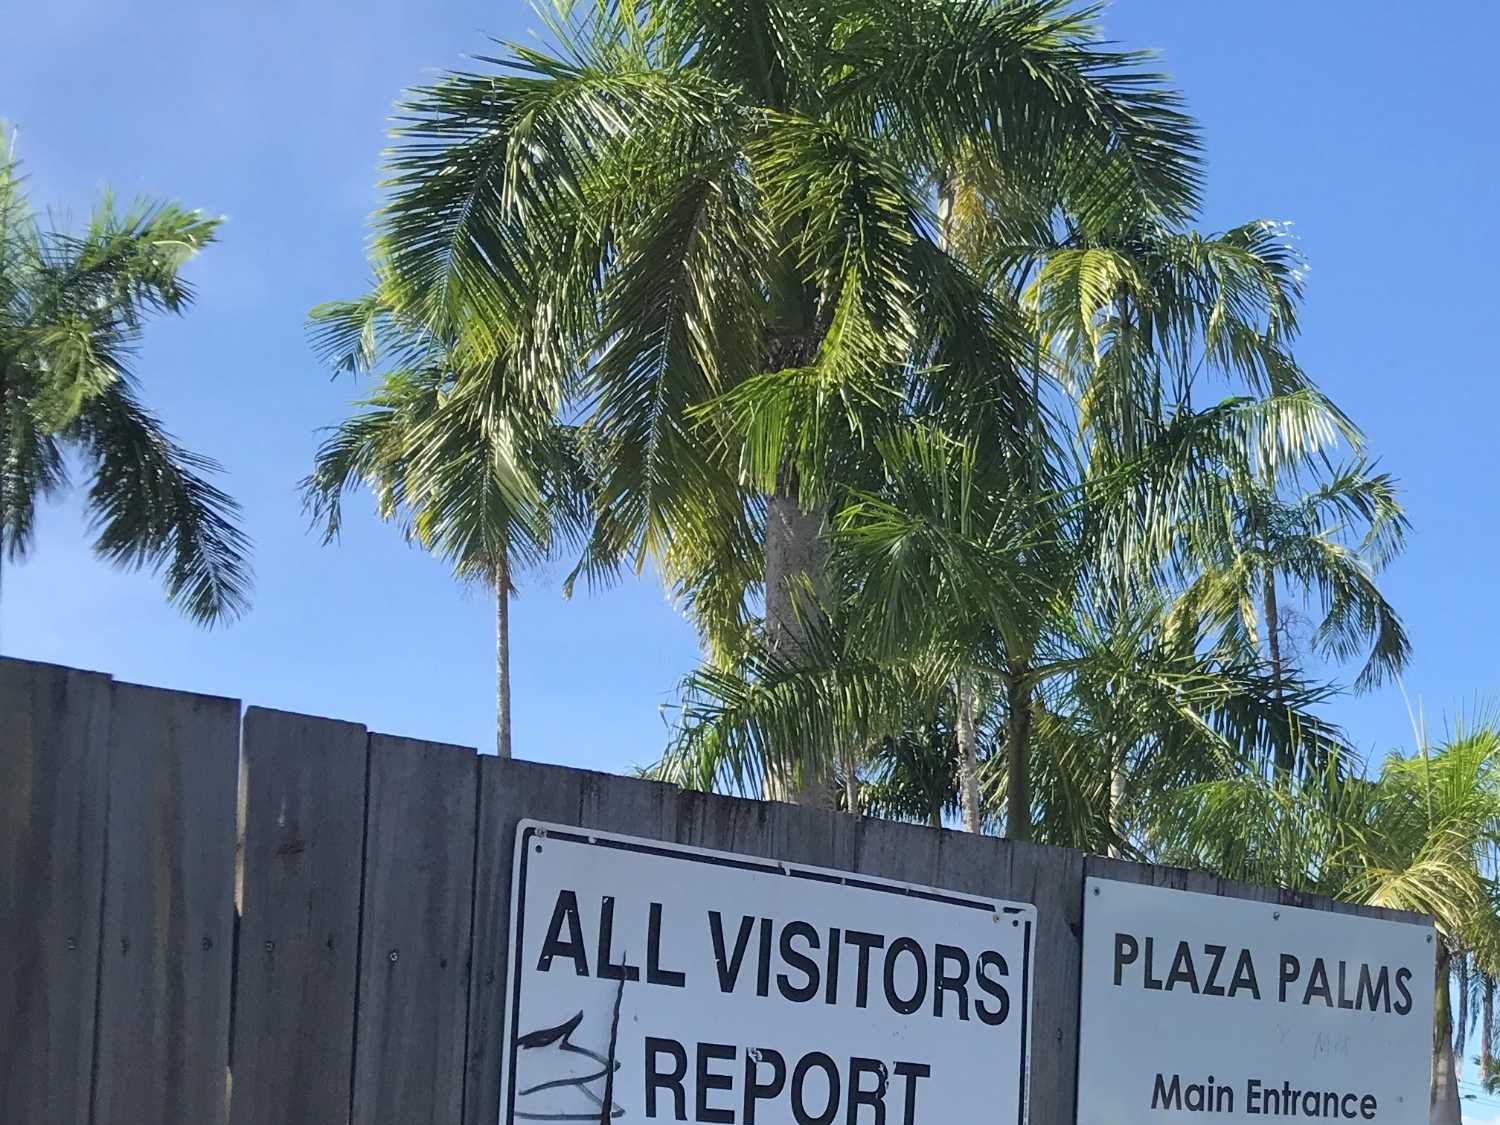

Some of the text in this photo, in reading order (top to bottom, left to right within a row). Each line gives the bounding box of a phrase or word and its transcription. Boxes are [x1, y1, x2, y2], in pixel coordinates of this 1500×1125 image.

[536, 889, 1010, 1026] ALL VISITORS
[1113, 932, 1413, 1016] PLAZA PALMS
[1150, 1072, 1379, 1120] Main Entrance
